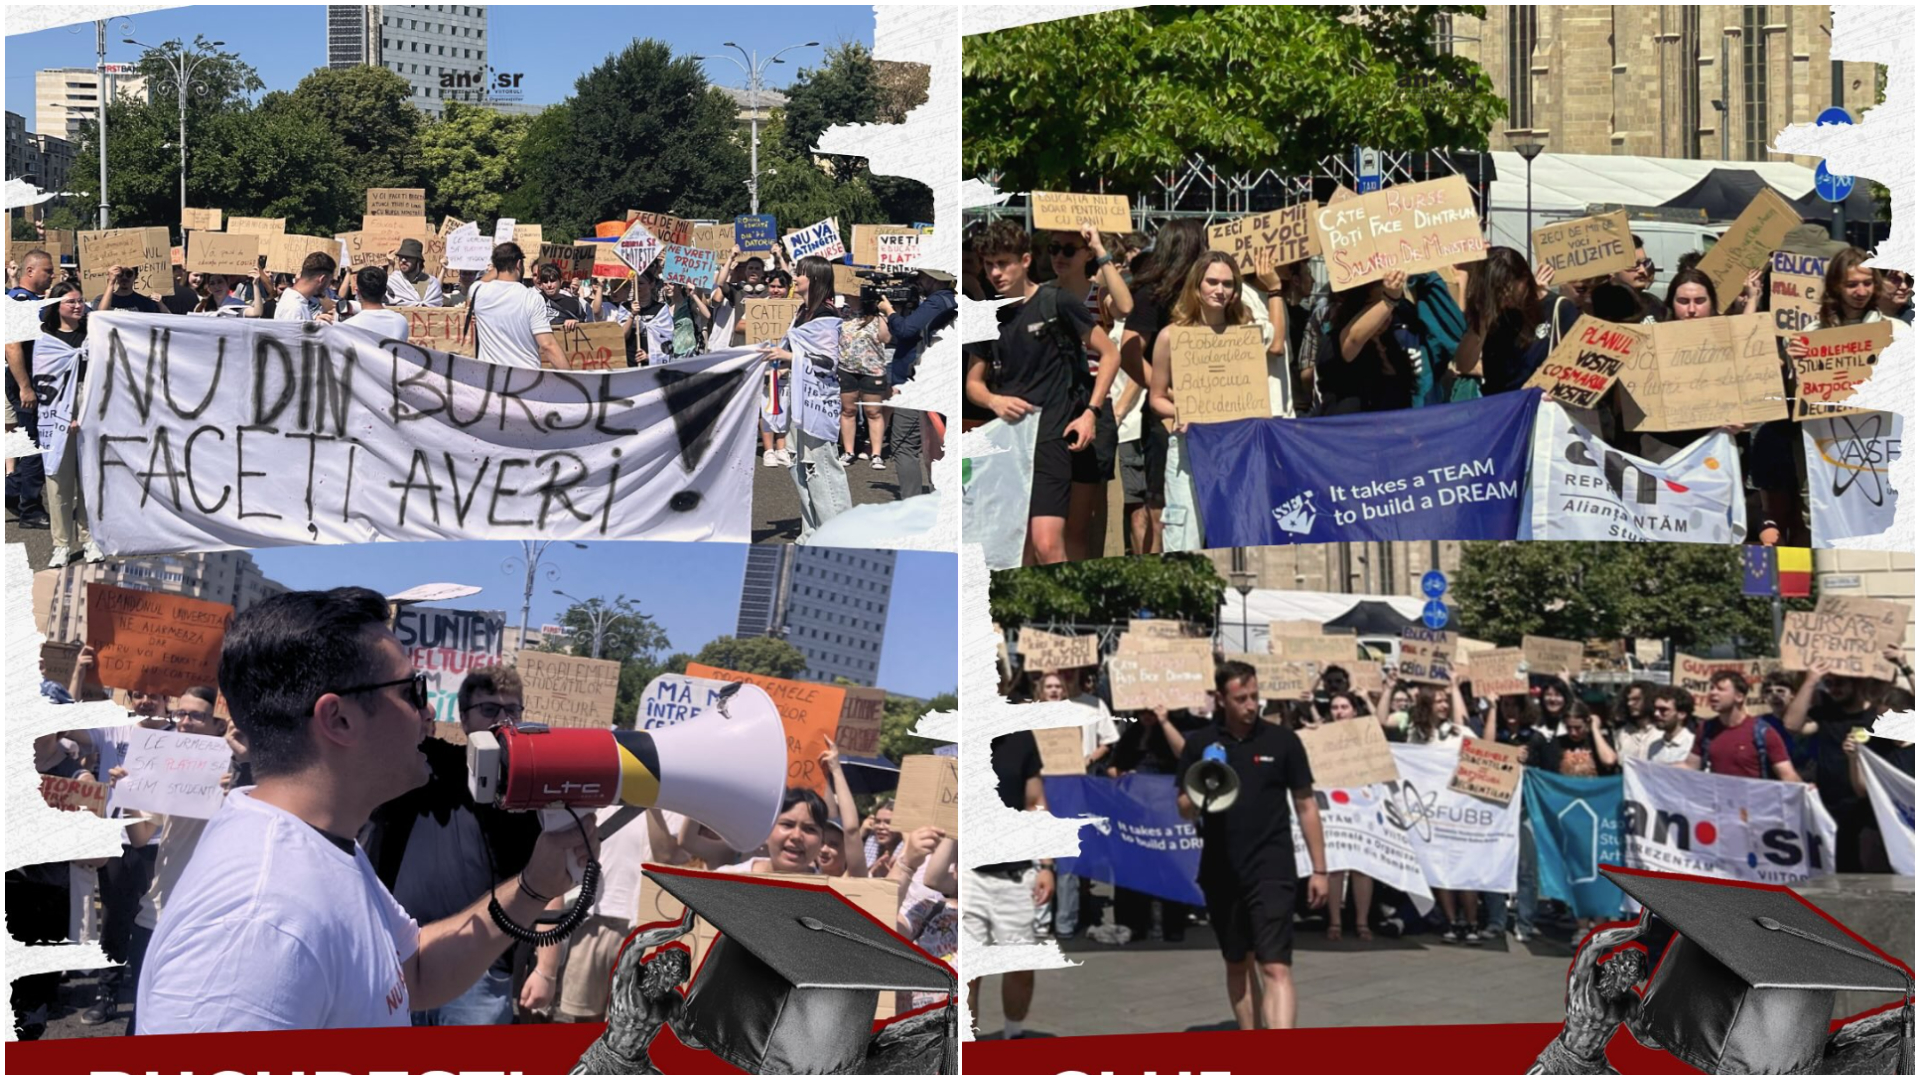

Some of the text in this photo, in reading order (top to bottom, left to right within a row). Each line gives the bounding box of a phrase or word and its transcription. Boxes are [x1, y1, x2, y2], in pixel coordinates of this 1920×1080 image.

[1362, 180, 1378, 191] TAXI
[1070, 205, 1108, 216] PENTRU
[1386, 188, 1447, 217] BURSE
[660, 216, 674, 228] DE
[1055, 215, 1071, 225] CU
[1253, 215, 1271, 230] DE
[1368, 215, 1403, 238] FACE
[790, 231, 811, 248] NU
[1235, 235, 1253, 251] DE
[1539, 231, 1564, 245] ZECI
[1568, 225, 1582, 238] DE
[668, 245, 680, 254] NE
[1774, 250, 1830, 277] EDUCAT
[1579, 326, 1634, 355] PLANUL
[1575, 349, 1625, 378] VOSTRU
[101, 328, 228, 427] NU
[377, 338, 638, 438] BURSE
[1548, 381, 1601, 406] NOSTRU
[1330, 457, 1495, 502] It takes a TEAM
[1333, 480, 1519, 526] to build a DREAM
[119, 616, 134, 630] NE
[396, 610, 505, 656] SUNTEM
[1785, 631, 1810, 648] NU
[103, 656, 135, 671] TOT
[525, 658, 620, 684] PROBLEMELE
[657, 679, 693, 704] MĂ
[1411, 801, 1494, 826] ASFUBB
[1129, 824, 1163, 837] takes
[1164, 826, 1174, 837] a
[1121, 833, 1135, 843] to
[1136, 836, 1166, 850] build
[1168, 839, 1177, 850] a
